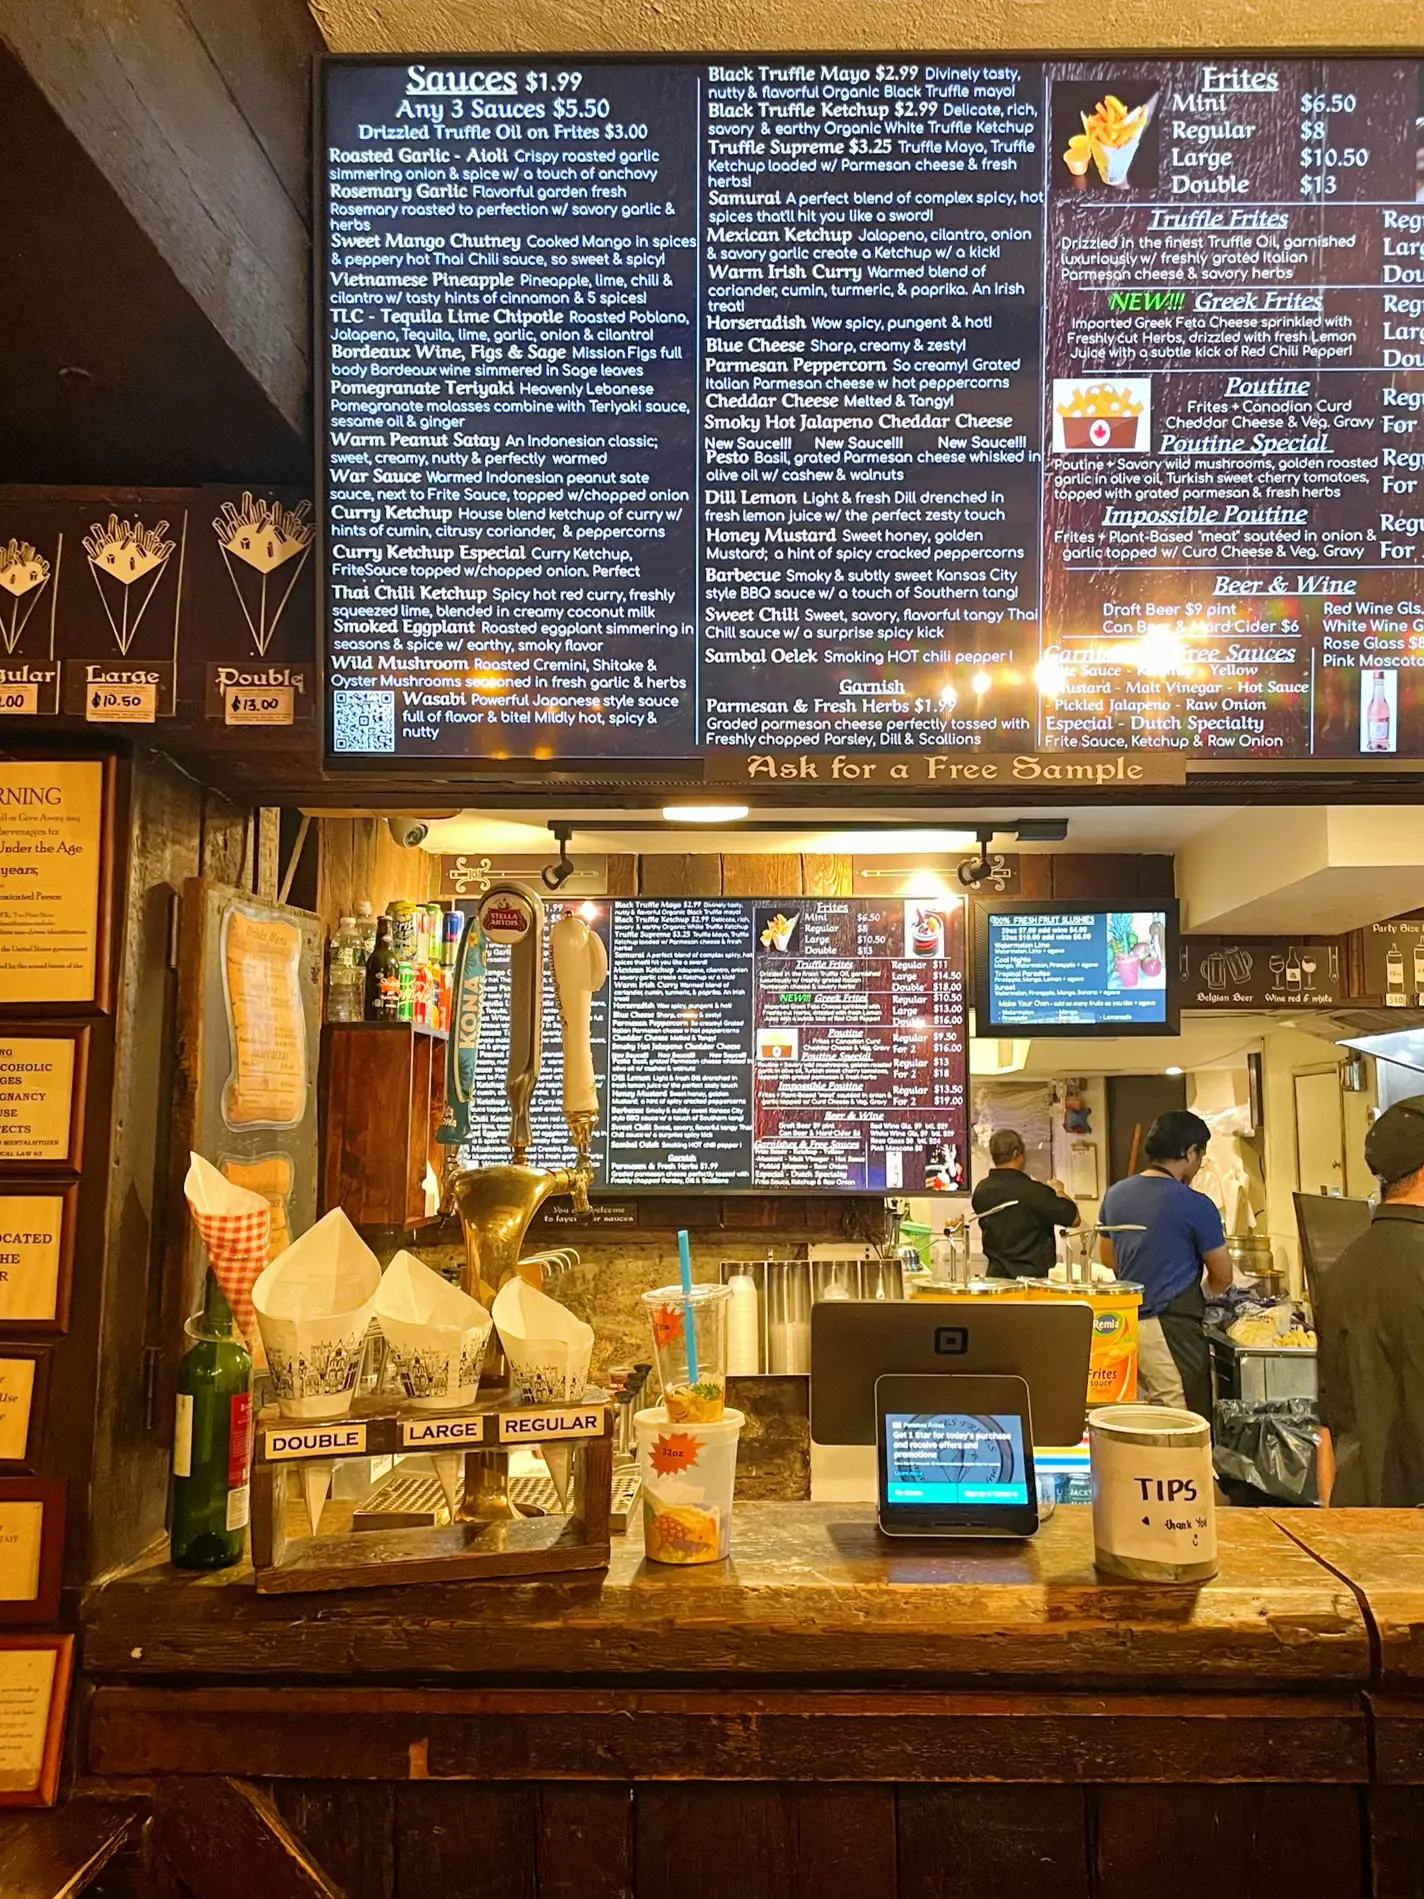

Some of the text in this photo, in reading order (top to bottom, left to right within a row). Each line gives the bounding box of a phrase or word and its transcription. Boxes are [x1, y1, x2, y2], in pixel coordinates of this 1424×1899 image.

[406, 66, 582, 95] Sauces $1.99
[708, 65, 1020, 84] Black Truffle Mayo $2.99 Divinely tasty,
[1202, 66, 1279, 92] Frites
[396, 97, 610, 122] Any 3 Sauces $5.50
[1171, 94, 1356, 114] Mini $6.50
[358, 123, 648, 140] Drizzled Truffle Oil on Frites $3.00
[1171, 121, 1324, 142] Regular $8
[1171, 148, 1368, 170] Large $10.50
[1171, 175, 1336, 195] Double $13
[1150, 210, 1288, 230] Truffle Frites
[1193, 292, 1257, 311] Greek
[1264, 292, 1323, 311] Frites
[1224, 378, 1310, 396] Poutine
[704, 414, 1012, 432] Smoky Hot Jalapeno Cheddar Cheese
[1159, 433, 1328, 455] Poutine Special
[1102, 506, 1308, 526] Impossible Poutine
[1213, 576, 1357, 595] Beer & Wine
[1104, 602, 1141, 615] Draft
[1146, 603, 1180, 615] Beer
[1186, 602, 1202, 616] $9
[334, 618, 694, 637] Smoked Eggplant Roasted eggplant simmering in
[86, 666, 159, 684] Large
[215, 667, 303, 695] Double
[839, 679, 905, 694] Garnish
[92, 691, 142, 709] $10.50
[231, 695, 279, 712] $13.00
[707, 699, 957, 714] Parmesan & Fresh Herbs $1.99
[748, 755, 1144, 784] Ask for a Free Sample
[36, 841, 54, 853] the
[56, 841, 82, 855] Age
[1, 865, 39, 878] years,
[490, 912, 518, 920] STELLA
[490, 919, 518, 927] ARTOIS
[1372, 924, 1397, 934] Party
[857, 935, 886, 945] $10.50
[805, 946, 837, 956] Double
[1197, 993, 1252, 1002] Belgian Beer
[1265, 994, 1285, 1002] Wine
[1288, 994, 1300, 1002] red
[458, 975, 481, 1050] KONA
[408, 1422, 478, 1441] LARGE
[505, 1413, 597, 1434] REGULAR
[271, 1431, 359, 1453] DOUBLE
[662, 1448, 683, 1457] 32oz
[1134, 1478, 1196, 1501] TIPS
[1165, 1518, 1207, 1530] thank You
